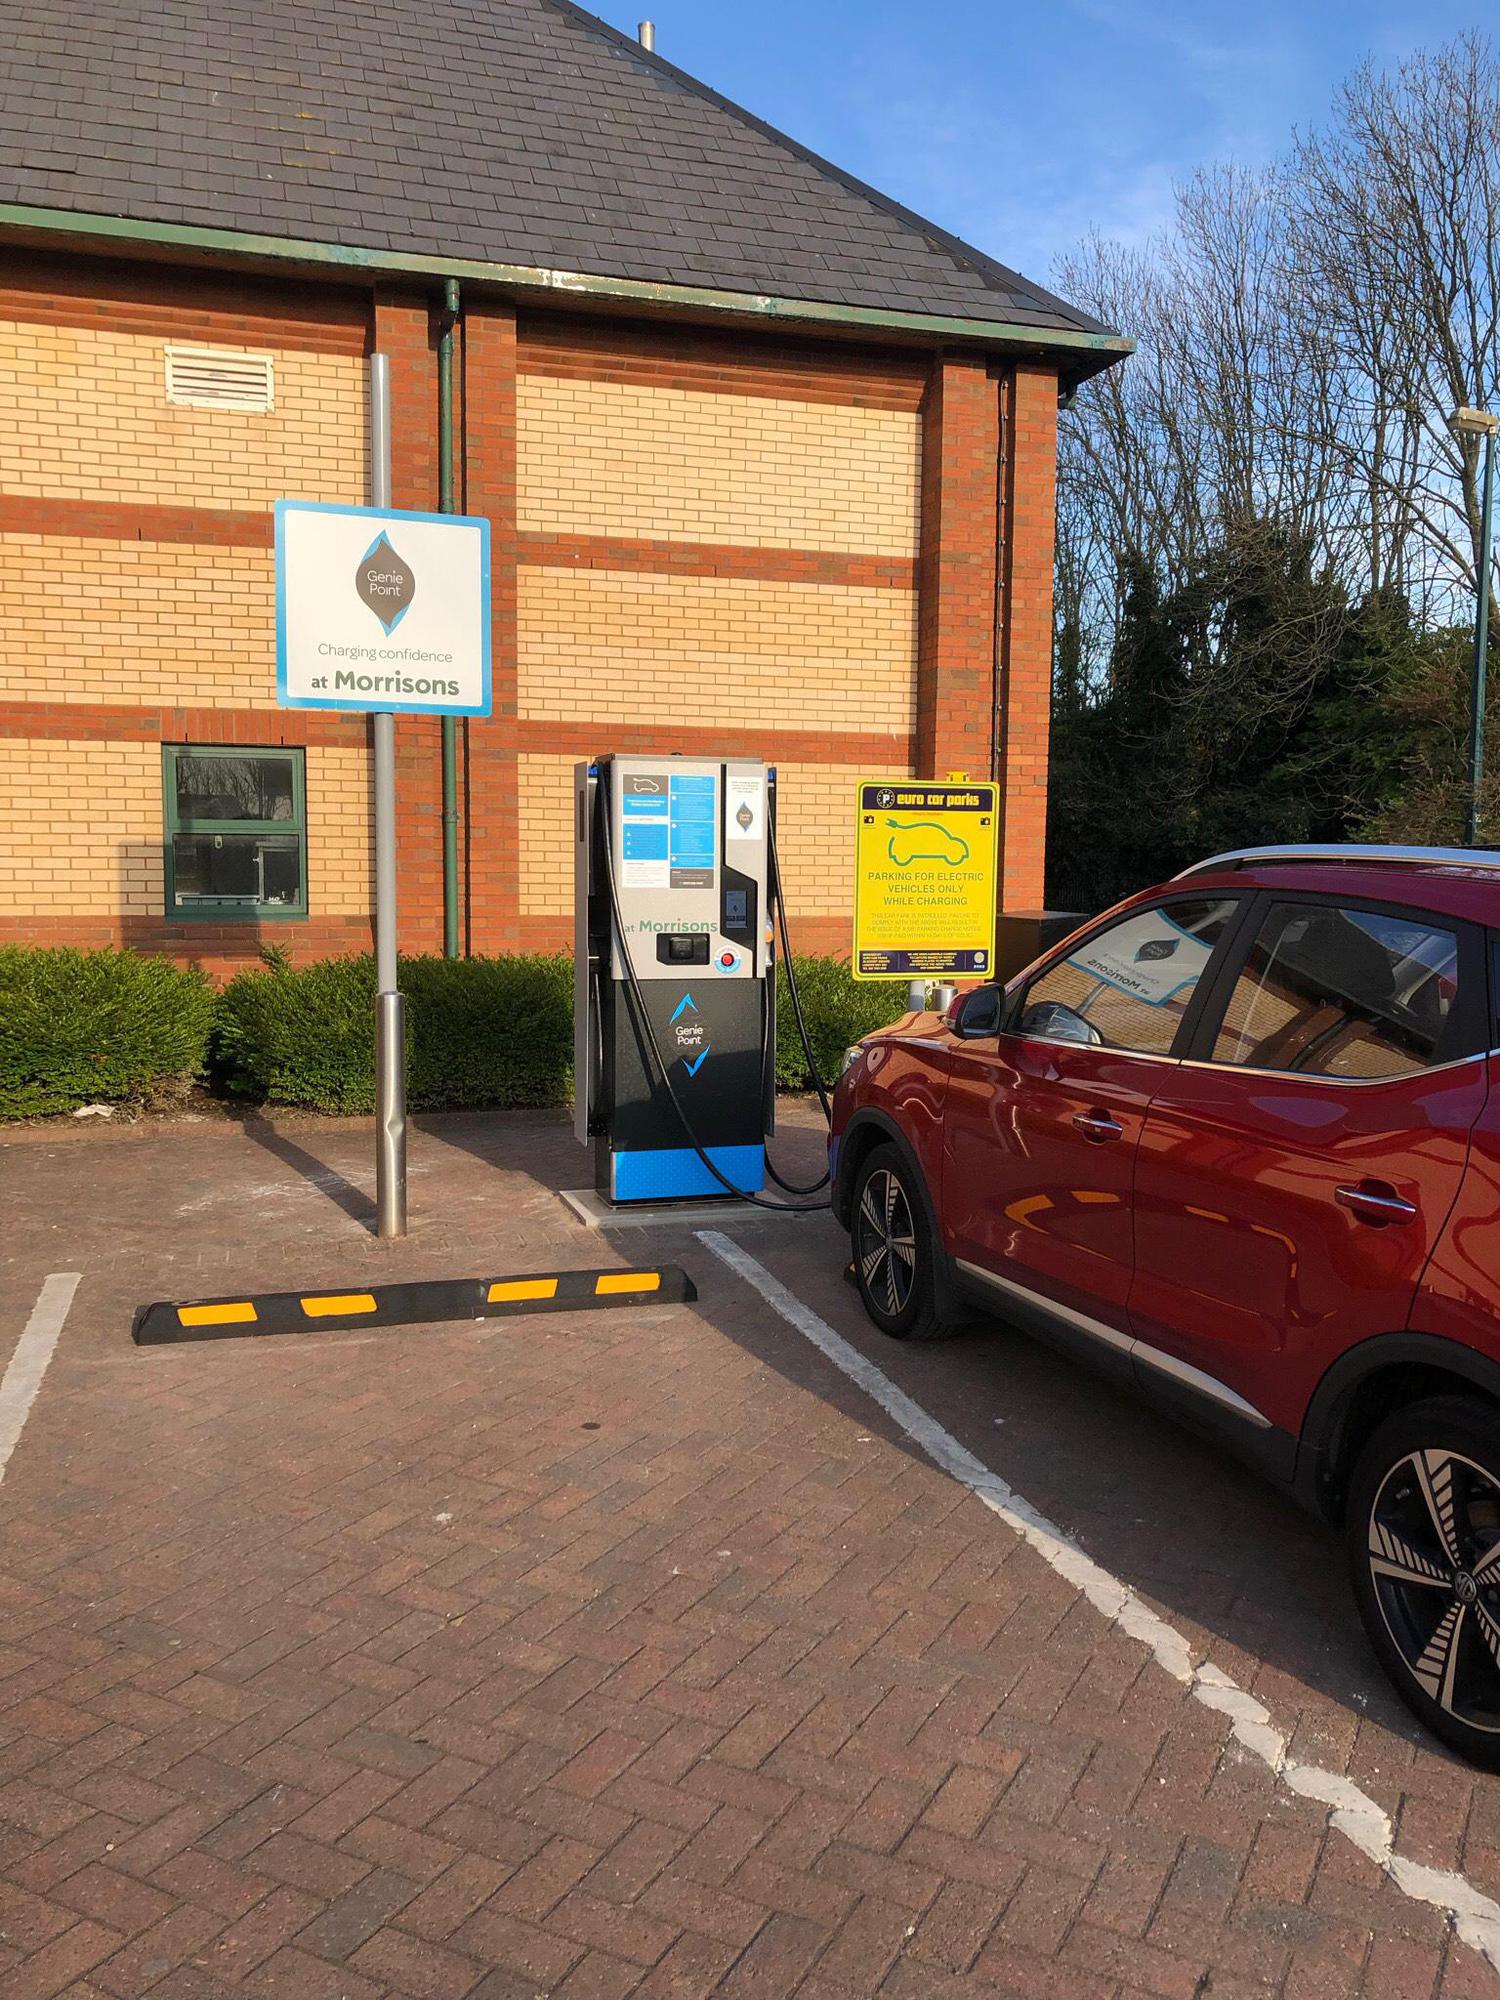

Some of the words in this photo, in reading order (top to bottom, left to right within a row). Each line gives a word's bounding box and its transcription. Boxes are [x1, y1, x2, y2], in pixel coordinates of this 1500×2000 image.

[367, 570, 404, 584] Genie
[370, 583, 401, 597] Point
[318, 643, 377, 662] Charging
[378, 647, 453, 663] confidence
[311, 676, 328, 689] at
[335, 670, 460, 696] Morrisons
[897, 794, 924, 805] euro
[927, 794, 945, 805] car
[946, 793, 980, 807] parks
[868, 872, 912, 881] PARKING
[914, 872, 934, 881] FOR
[937, 872, 984, 882] ELECTRIC
[888, 884, 935, 893] VEHICLES
[938, 884, 964, 893] ONLY
[884, 896, 914, 905] WHILE
[917, 896, 968, 905] CHARGING
[625, 924, 634, 932] at
[639, 918, 718, 932] Morrisons
[675, 1024, 704, 1036] Genie
[677, 1036, 702, 1046] Point
